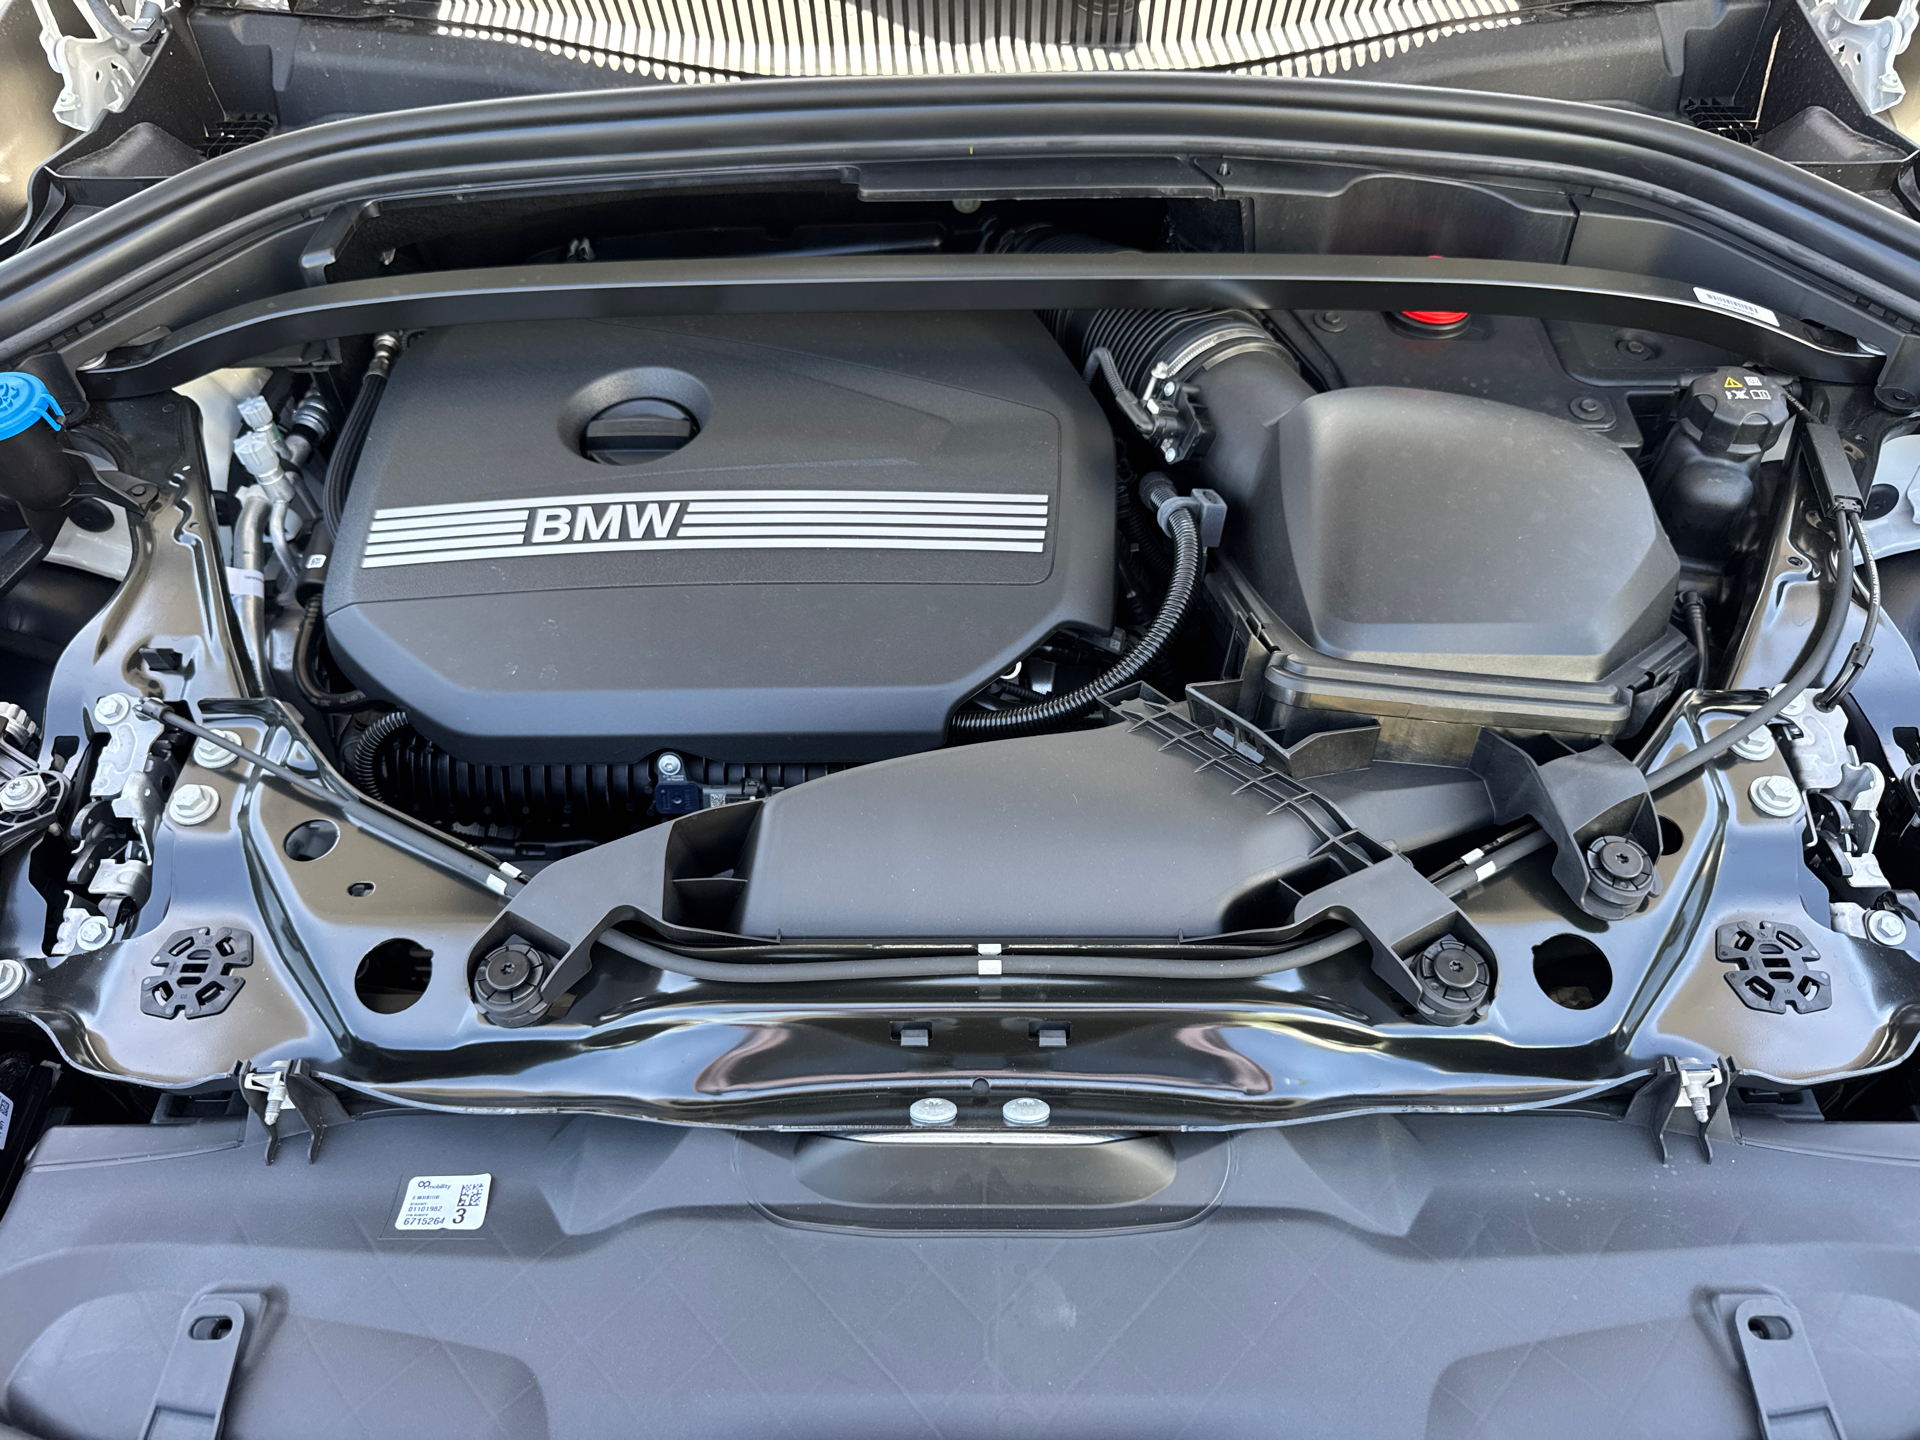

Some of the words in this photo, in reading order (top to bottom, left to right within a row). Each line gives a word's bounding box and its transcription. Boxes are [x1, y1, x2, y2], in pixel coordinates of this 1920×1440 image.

[531, 502, 681, 544] BMW
[403, 1217, 446, 1225] 6715264
[452, 1208, 467, 1224] 3
